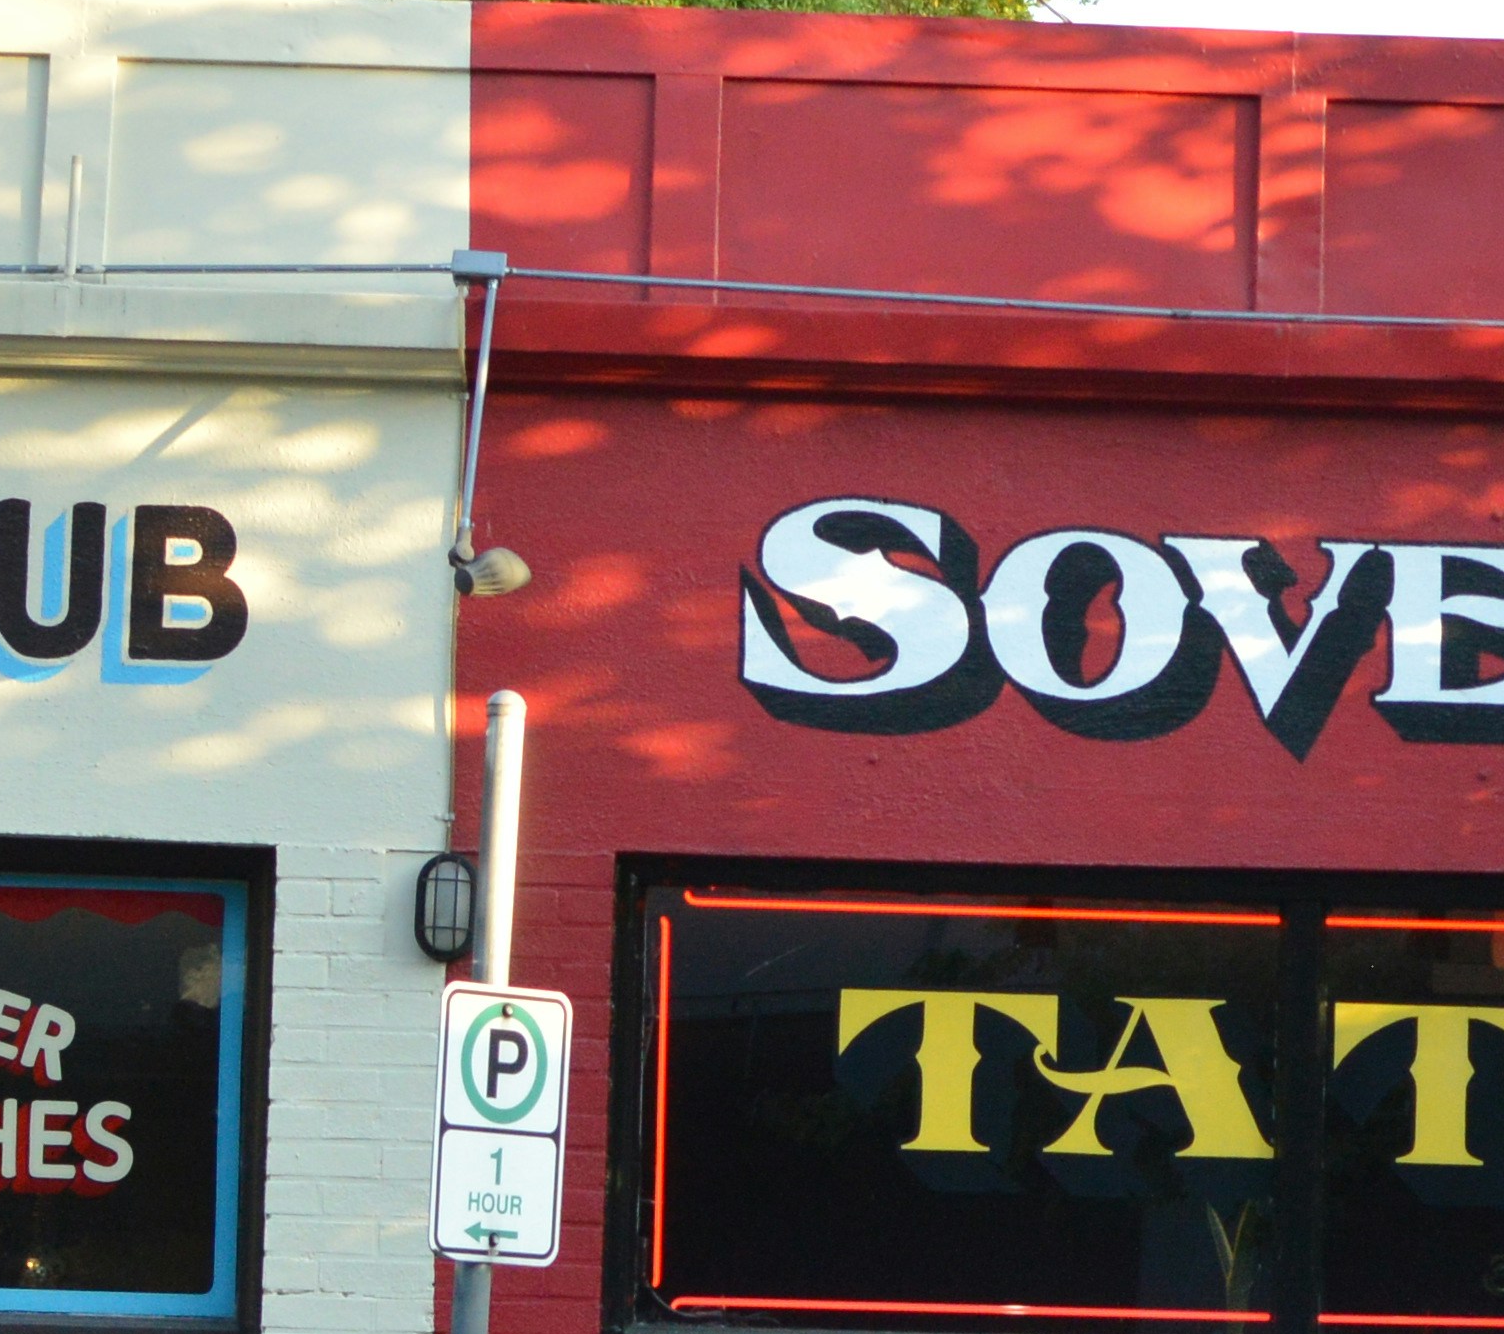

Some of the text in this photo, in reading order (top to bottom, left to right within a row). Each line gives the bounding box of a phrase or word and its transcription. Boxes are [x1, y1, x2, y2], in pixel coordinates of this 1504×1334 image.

[486, 1028, 528, 1100] P
[487, 1147, 505, 1187] 1
[467, 1190, 523, 1217] HOUR
